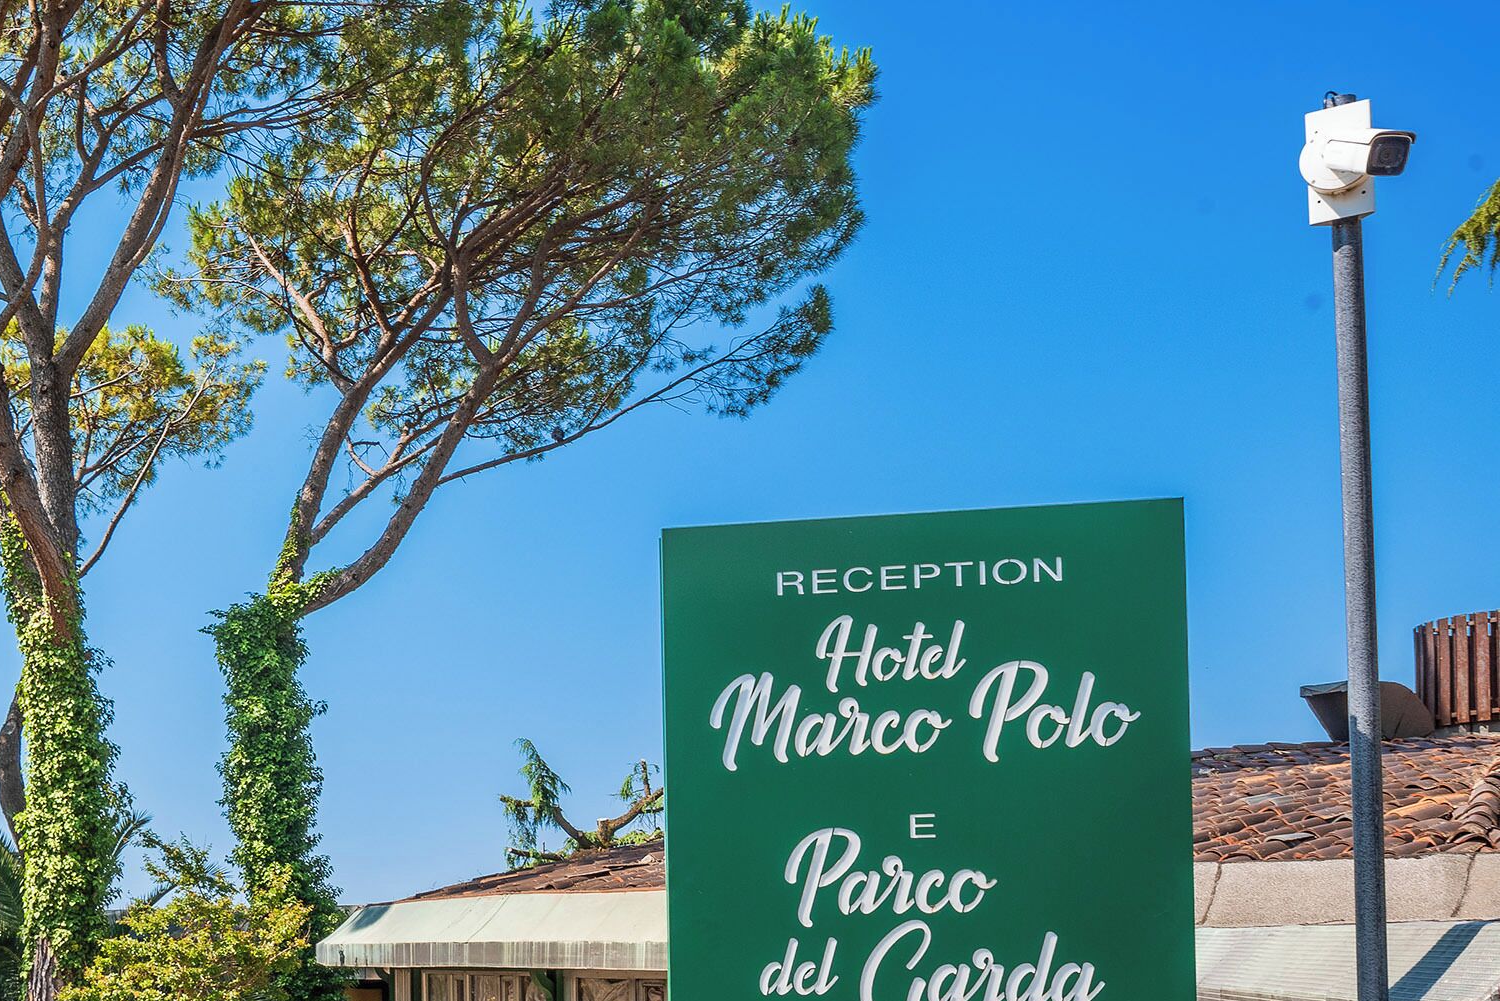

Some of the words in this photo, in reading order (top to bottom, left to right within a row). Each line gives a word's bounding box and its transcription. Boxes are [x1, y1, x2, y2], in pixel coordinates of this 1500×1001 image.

[777, 557, 1063, 595] RECEPTION
[816, 615, 967, 693] Hotel
[710, 672, 952, 772] Marco
[969, 661, 1141, 763] Polo
[909, 814, 936, 839] E
[784, 828, 998, 928] Parco
[759, 937, 839, 996] del
